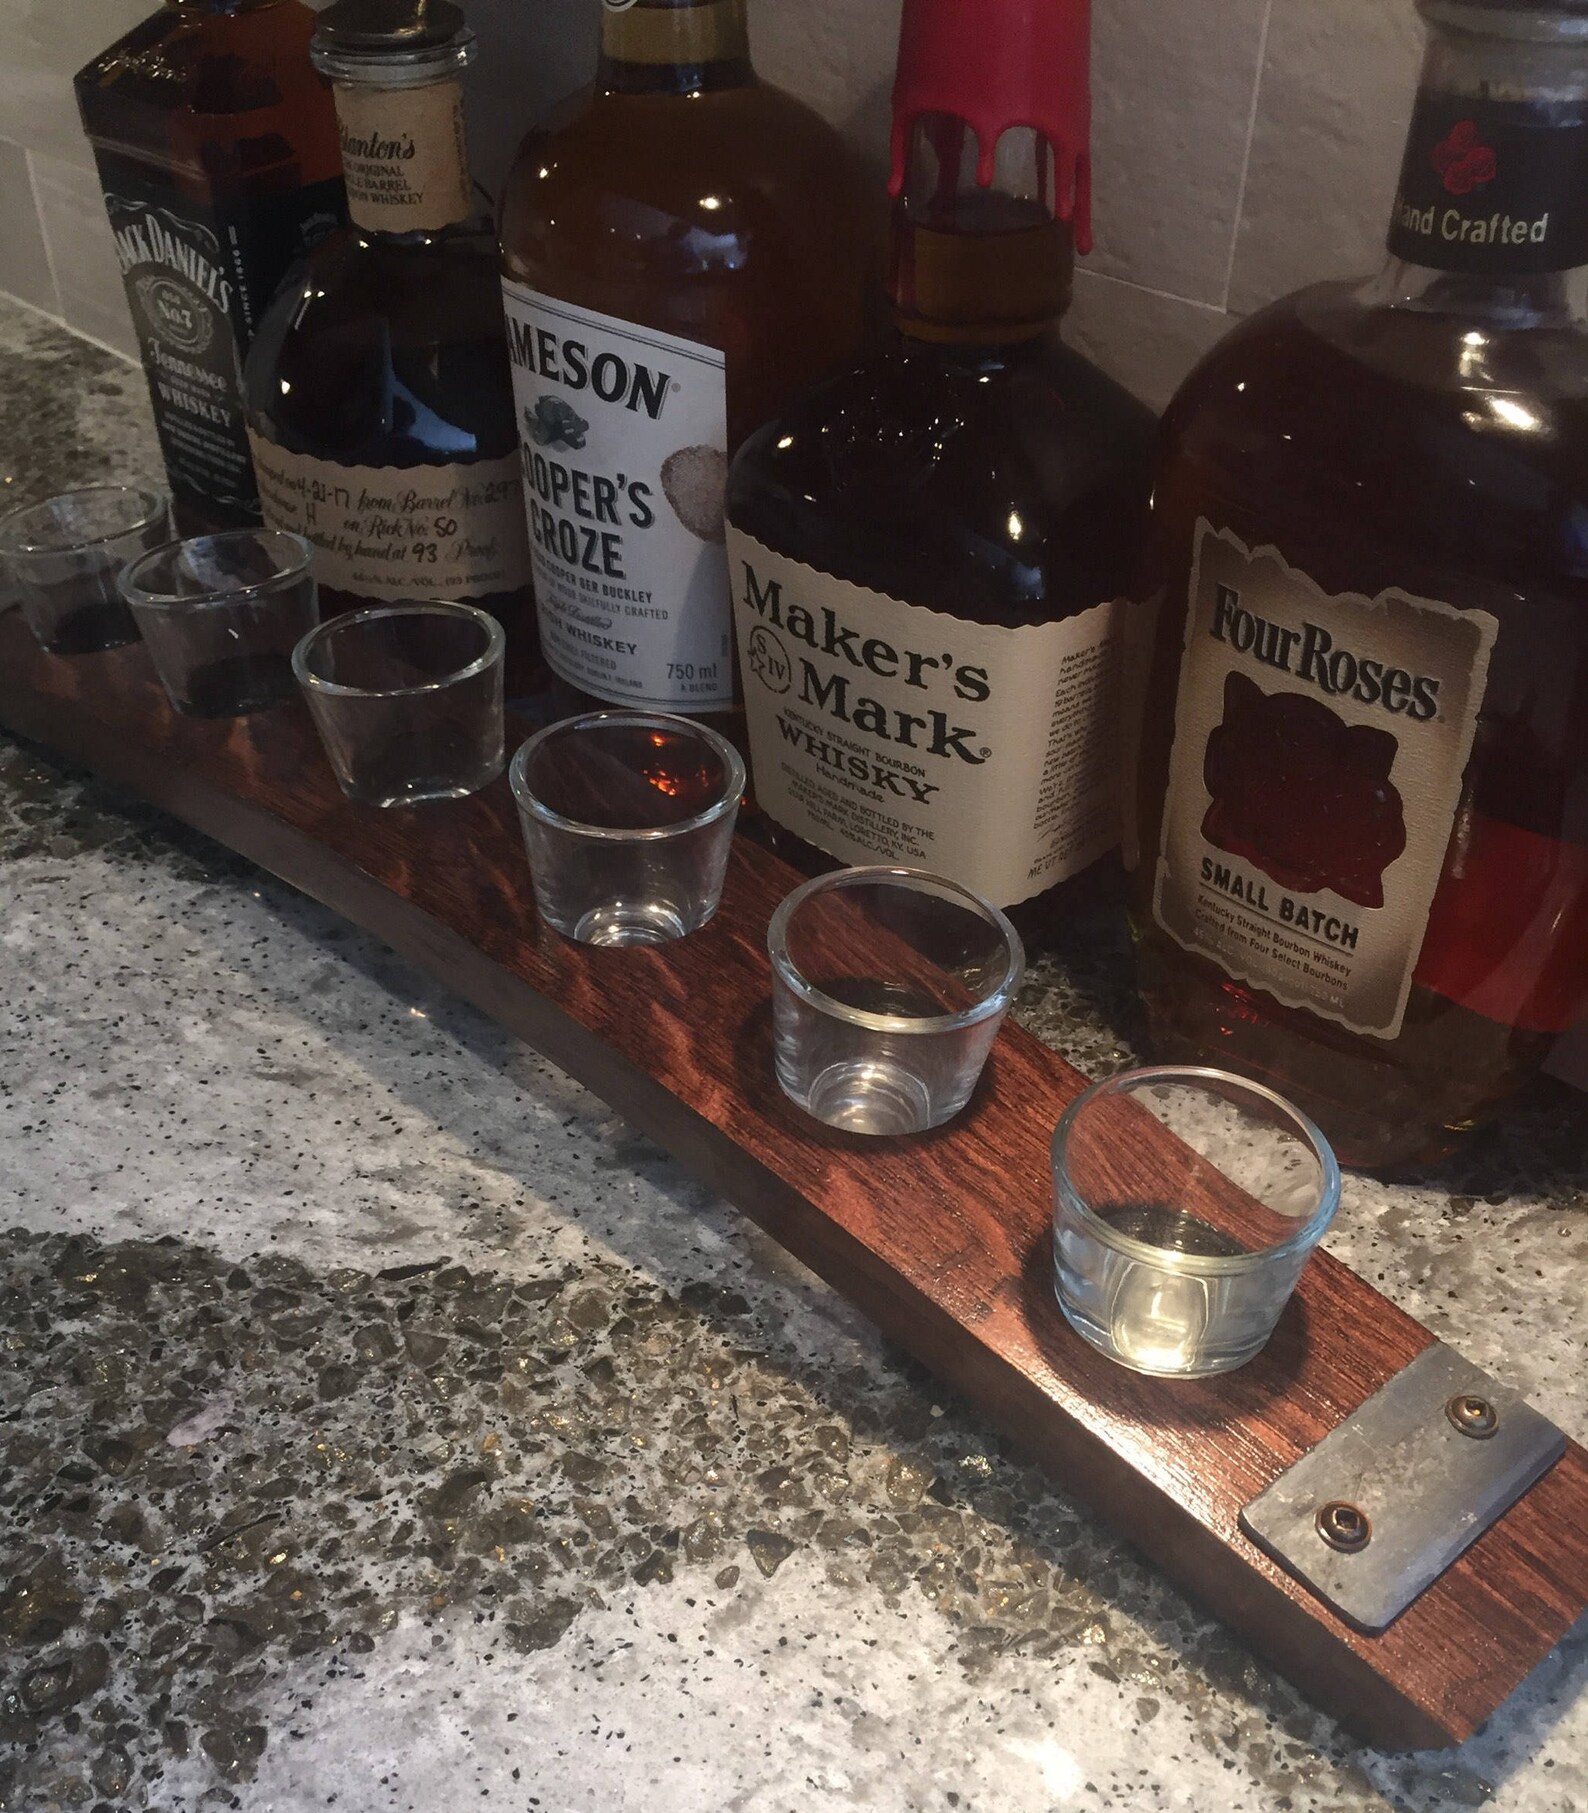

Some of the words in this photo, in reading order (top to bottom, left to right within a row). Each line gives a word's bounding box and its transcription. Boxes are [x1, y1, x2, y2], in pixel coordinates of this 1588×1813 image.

[370, 192, 424, 205] WHISKEY
[1401, 204, 1436, 235] and
[1441, 208, 1549, 244] Crafted
[145, 213, 234, 314] DANIEL'S
[157, 381, 231, 428] WHISKEY
[400, 488, 453, 514] Barrel
[434, 516, 458, 538] 50
[530, 498, 626, 580] CROZE
[412, 542, 438, 564] 93
[602, 584, 652, 604] BUCKLEY
[624, 606, 668, 620] CRAFTED
[566, 626, 638, 655] WHISKEY
[742, 560, 990, 702] Maker's
[667, 663, 693, 680] 750
[1209, 582, 1302, 673] Four
[1295, 621, 1441, 721] Roses
[798, 657, 986, 765] Mark
[776, 714, 939, 805] WHISKY
[827, 731, 871, 758] STRAIGHT
[875, 752, 925, 778] BOURBON
[816, 762, 885, 803] Handmade
[860, 805, 899, 828] BOTTLED
[902, 823, 914, 833] BY
[916, 827, 935, 841] THE
[901, 833, 920, 846] INC.
[907, 846, 926, 859] USA
[1200, 856, 1269, 911] SMALL
[1279, 896, 1359, 949] BATCH
[1195, 908, 1225, 933] Crafted
[1227, 926, 1247, 945] from
[1250, 937, 1270, 955] Four
[1272, 948, 1301, 970] Select
[1303, 962, 1349, 991] Bourbons
[1197, 894, 1236, 924] Kentucky
[1236, 915, 1271, 940] Straight
[1273, 933, 1310, 959] Bourbon
[1313, 950, 1352, 978] Whiskey
